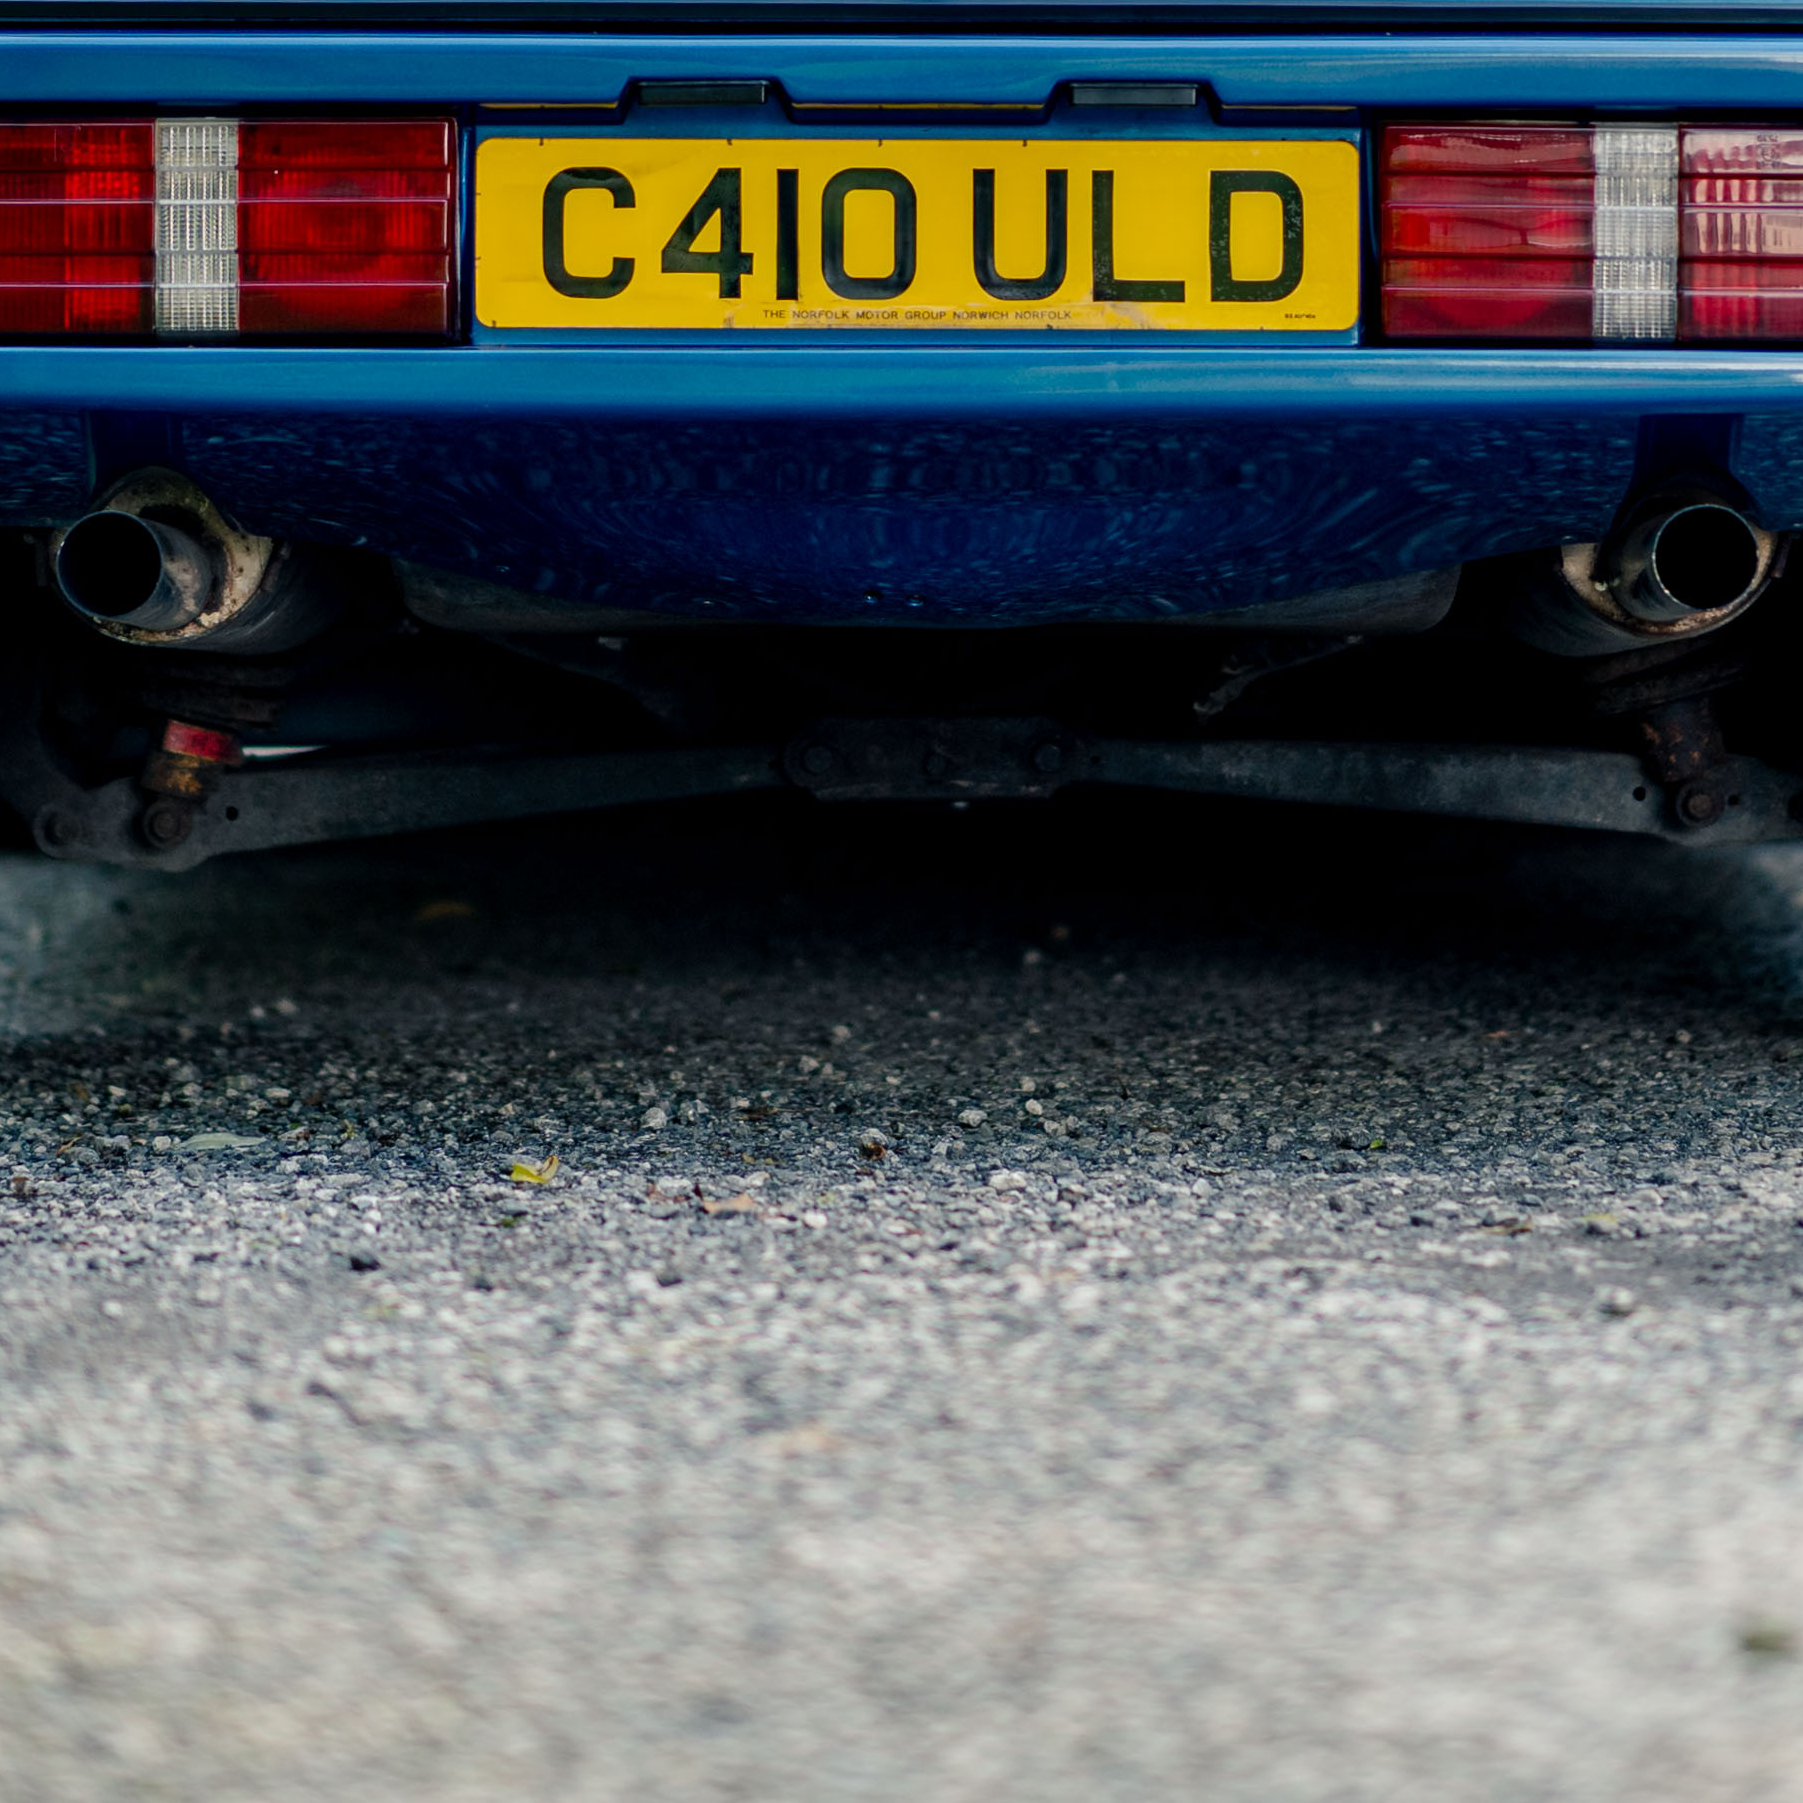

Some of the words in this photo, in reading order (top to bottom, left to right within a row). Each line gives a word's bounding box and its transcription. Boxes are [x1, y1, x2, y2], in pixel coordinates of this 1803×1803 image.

[541, 166, 918, 301] C410
[972, 168, 1306, 303] ULD
[763, 309, 786, 319] THE
[792, 309, 850, 320] NORFOLK
[856, 310, 898, 320] MOTOR
[904, 310, 947, 320] GROUP
[953, 310, 1009, 320] NORWICH
[1014, 310, 1072, 320] NORFOLK
